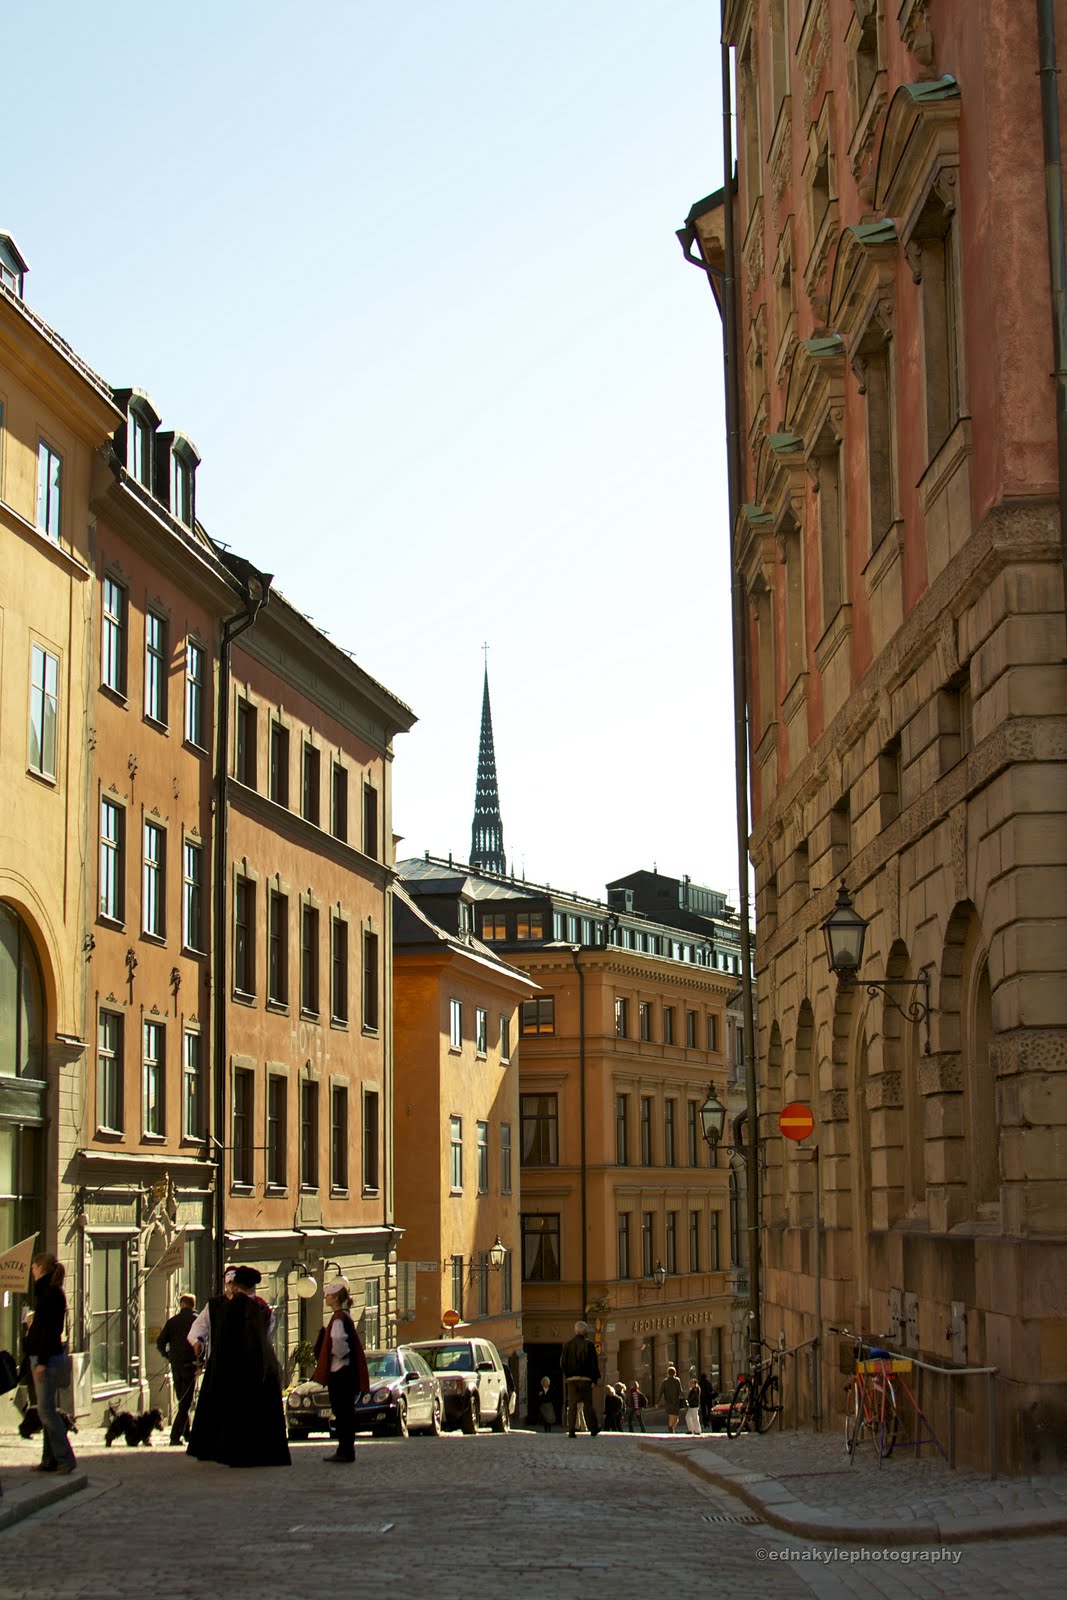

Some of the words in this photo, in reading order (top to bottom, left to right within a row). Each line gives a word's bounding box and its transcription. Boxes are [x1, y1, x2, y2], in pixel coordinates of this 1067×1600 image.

[290, 1020, 331, 1062] HOTEL
[633, 1316, 678, 1332] APOTEKET
[682, 1312, 713, 1326] KORPEN
